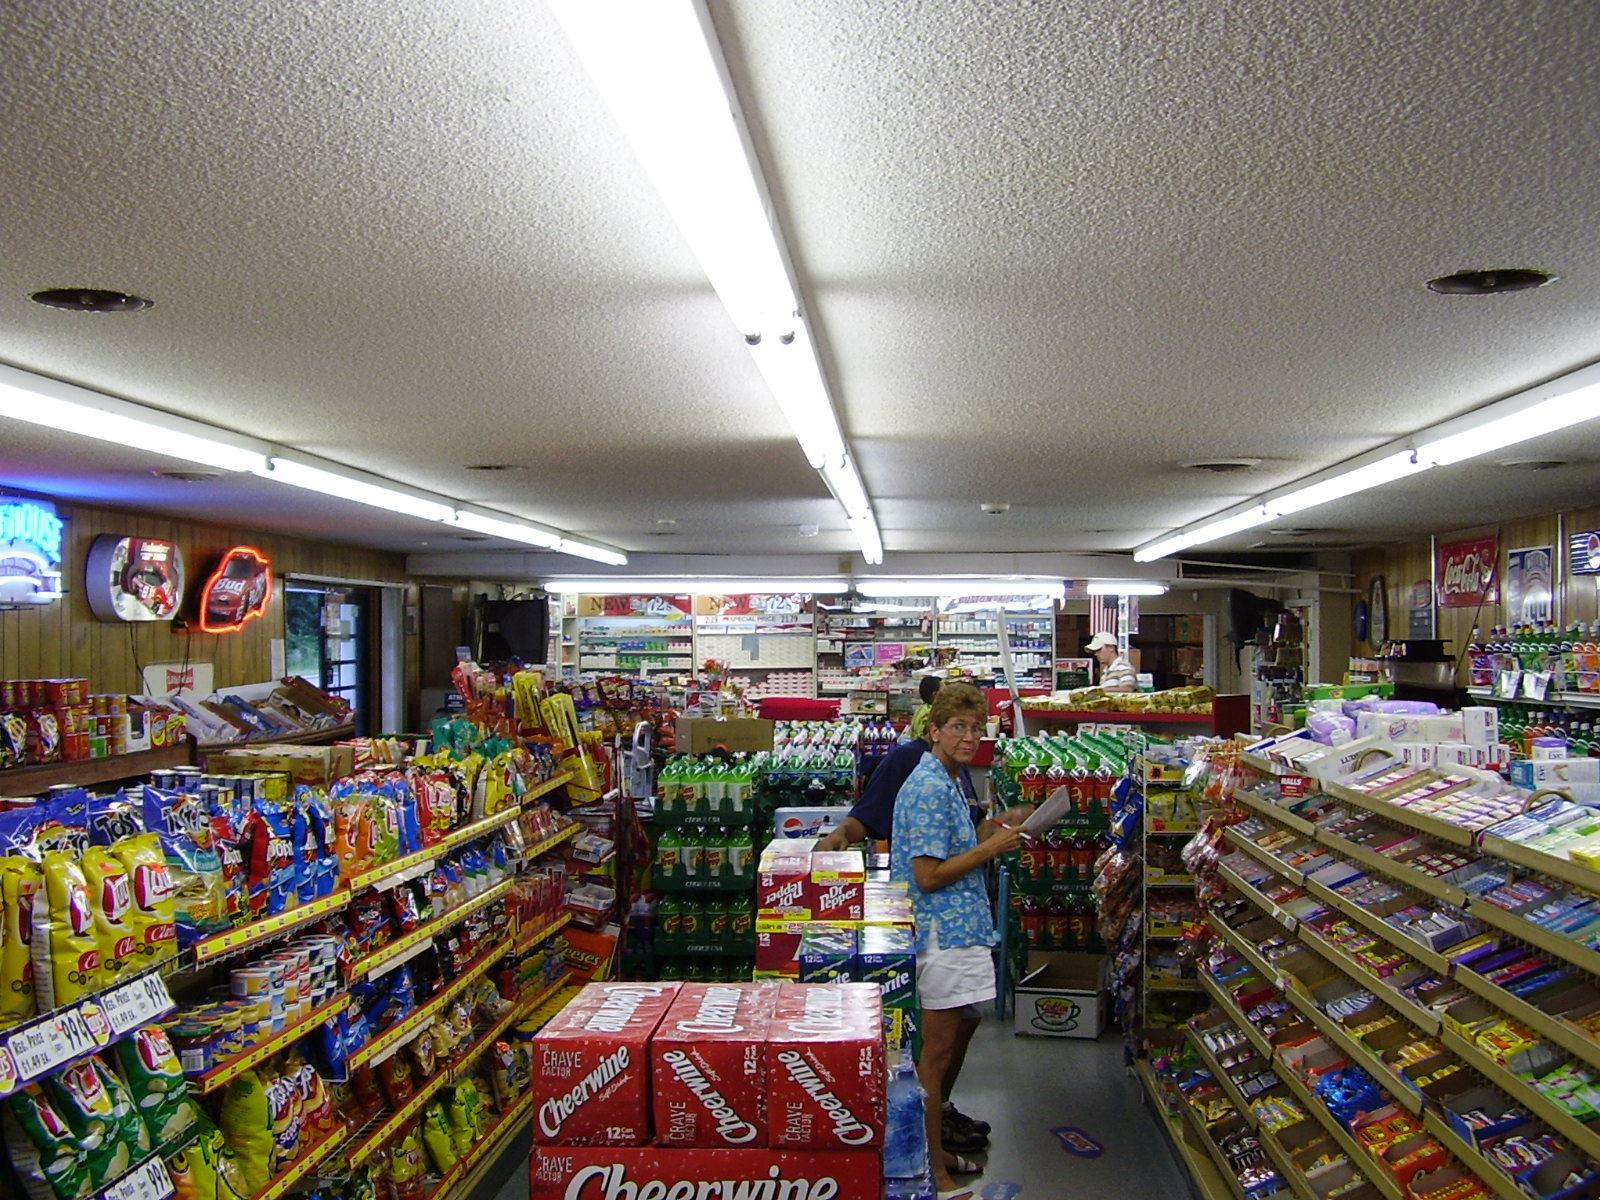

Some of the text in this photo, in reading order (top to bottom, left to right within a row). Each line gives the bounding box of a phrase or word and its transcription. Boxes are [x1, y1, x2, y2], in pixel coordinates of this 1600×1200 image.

[213, 578, 246, 591] Bud
[1281, 777, 1302, 785] HALLS
[764, 881, 804, 904] Pepper
[819, 888, 859, 911] Pepper
[829, 885, 844, 898] Dr
[848, 905, 861, 914] 12
[758, 934, 771, 942] 12
[543, 1051, 582, 1068] CRAVE
[541, 1066, 571, 1078] FACTOR
[744, 1060, 757, 1076] 12
[858, 1060, 872, 1076] 12
[539, 1046, 630, 1138] Cheerwine
[662, 1050, 758, 1144] Cheerwine
[777, 1050, 874, 1145] Cheerwine
[669, 1101, 686, 1141] CRAVE
[685, 1113, 697, 1142] FACTOR
[786, 1101, 803, 1141] CRAVE
[801, 1113, 814, 1143] FACTOR
[606, 1127, 622, 1139] 12
[541, 1156, 573, 1172] RAVE
